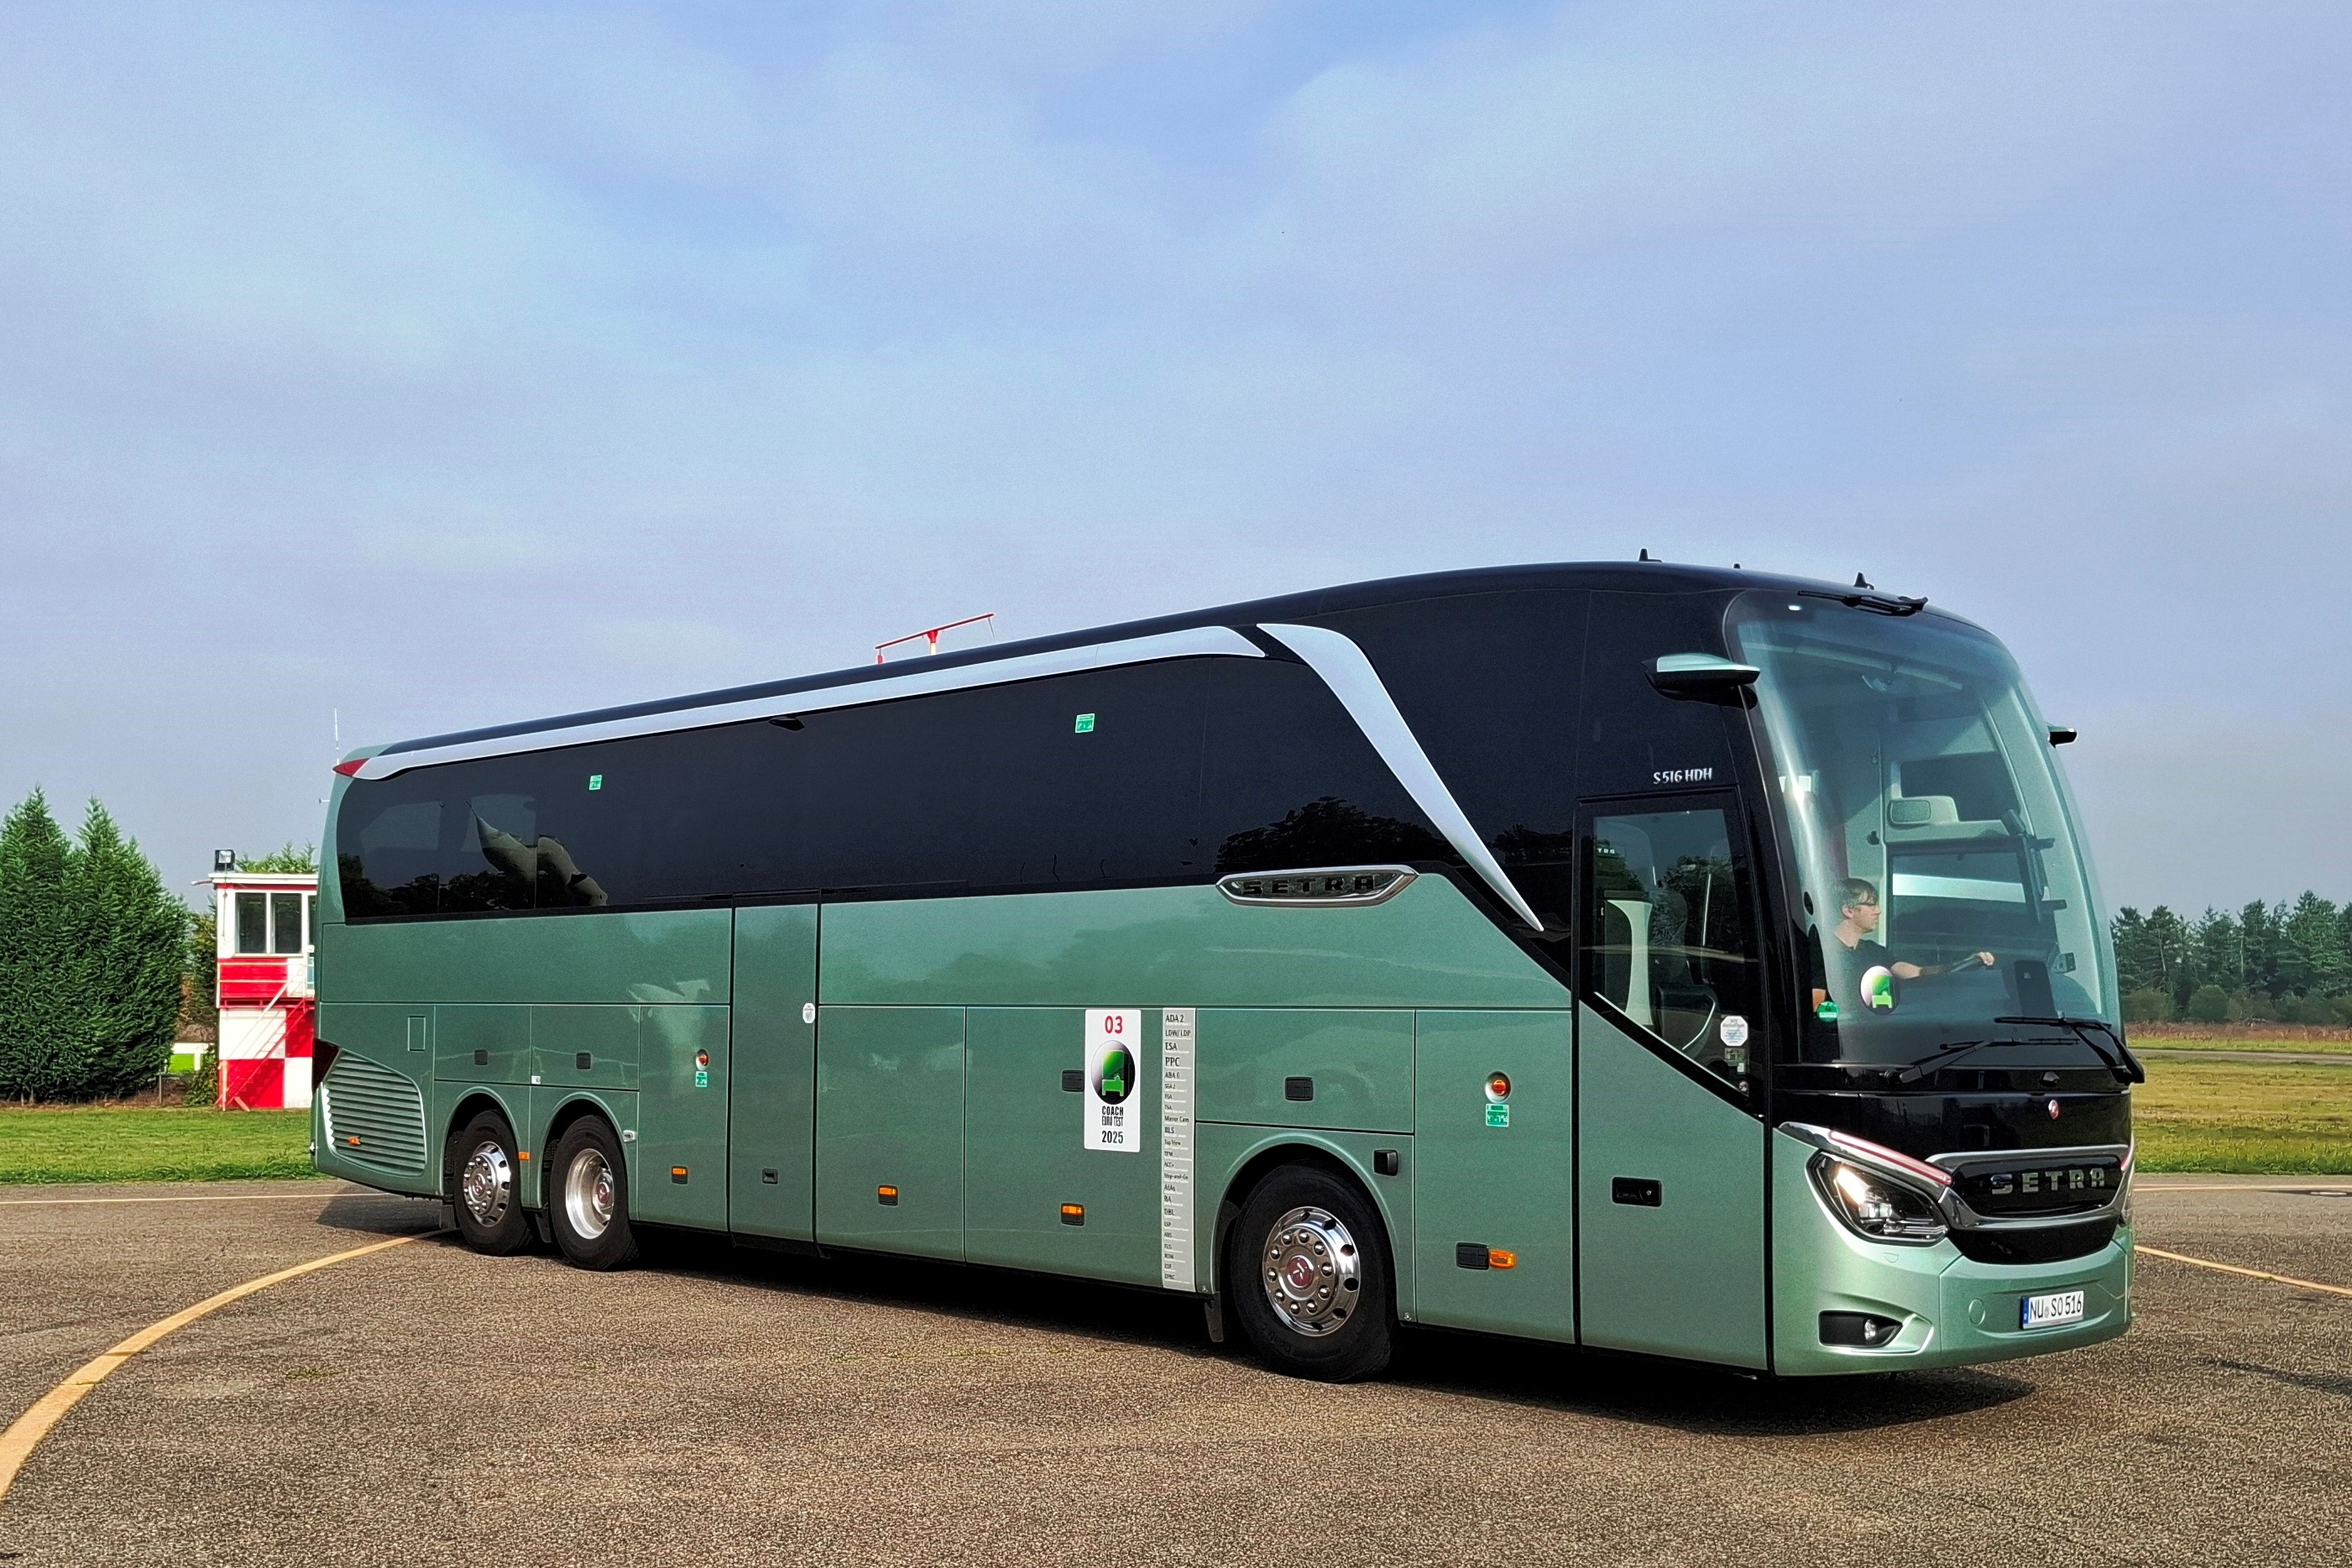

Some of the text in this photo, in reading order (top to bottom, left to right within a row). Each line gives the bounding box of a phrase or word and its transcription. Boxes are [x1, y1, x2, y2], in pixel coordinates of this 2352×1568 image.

[1653, 767, 1712, 785] S 516 HDH
[1241, 875, 1376, 895] SETRA
[1104, 1015, 1123, 1034] 03
[1166, 1014, 1184, 1022] ADA 2
[1165, 1057, 1180, 1067] PPC
[1102, 1105, 1123, 1116] COACH
[1102, 1116, 1123, 1126] EURO TEST
[1102, 1131, 1123, 1143] 2025
[1990, 1168, 2105, 1195] SETRA
[2030, 1299, 2045, 1320] NU
[2065, 1294, 2082, 1315] 516
